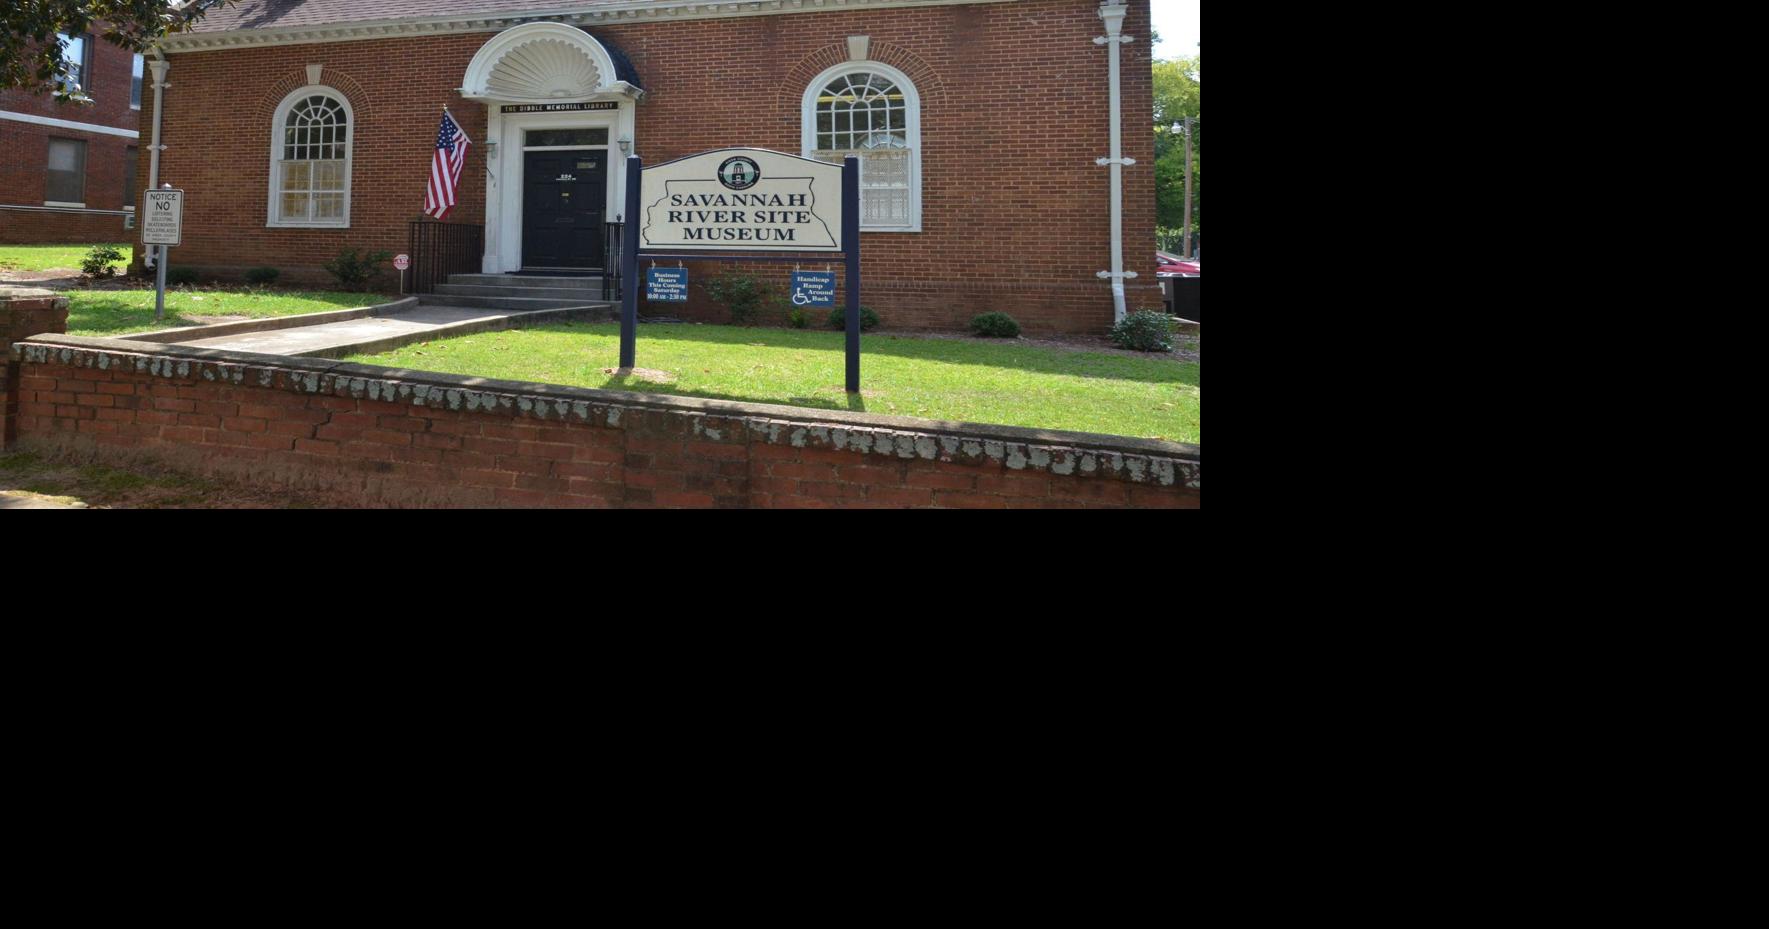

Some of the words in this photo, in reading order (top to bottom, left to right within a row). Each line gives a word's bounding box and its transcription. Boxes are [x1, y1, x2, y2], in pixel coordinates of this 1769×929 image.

[546, 103, 580, 111] MEMORIAL
[584, 102, 613, 110] LIBRARY
[150, 193, 177, 201] NOTICE
[671, 194, 807, 207] SAVANNAH
[155, 201, 171, 211] NO
[667, 210, 747, 223] RIVER
[754, 210, 811, 224] SITE
[683, 227, 796, 241] MUSEUM
[797, 276, 830, 284] Handicap
[803, 282, 823, 290] Ramp
